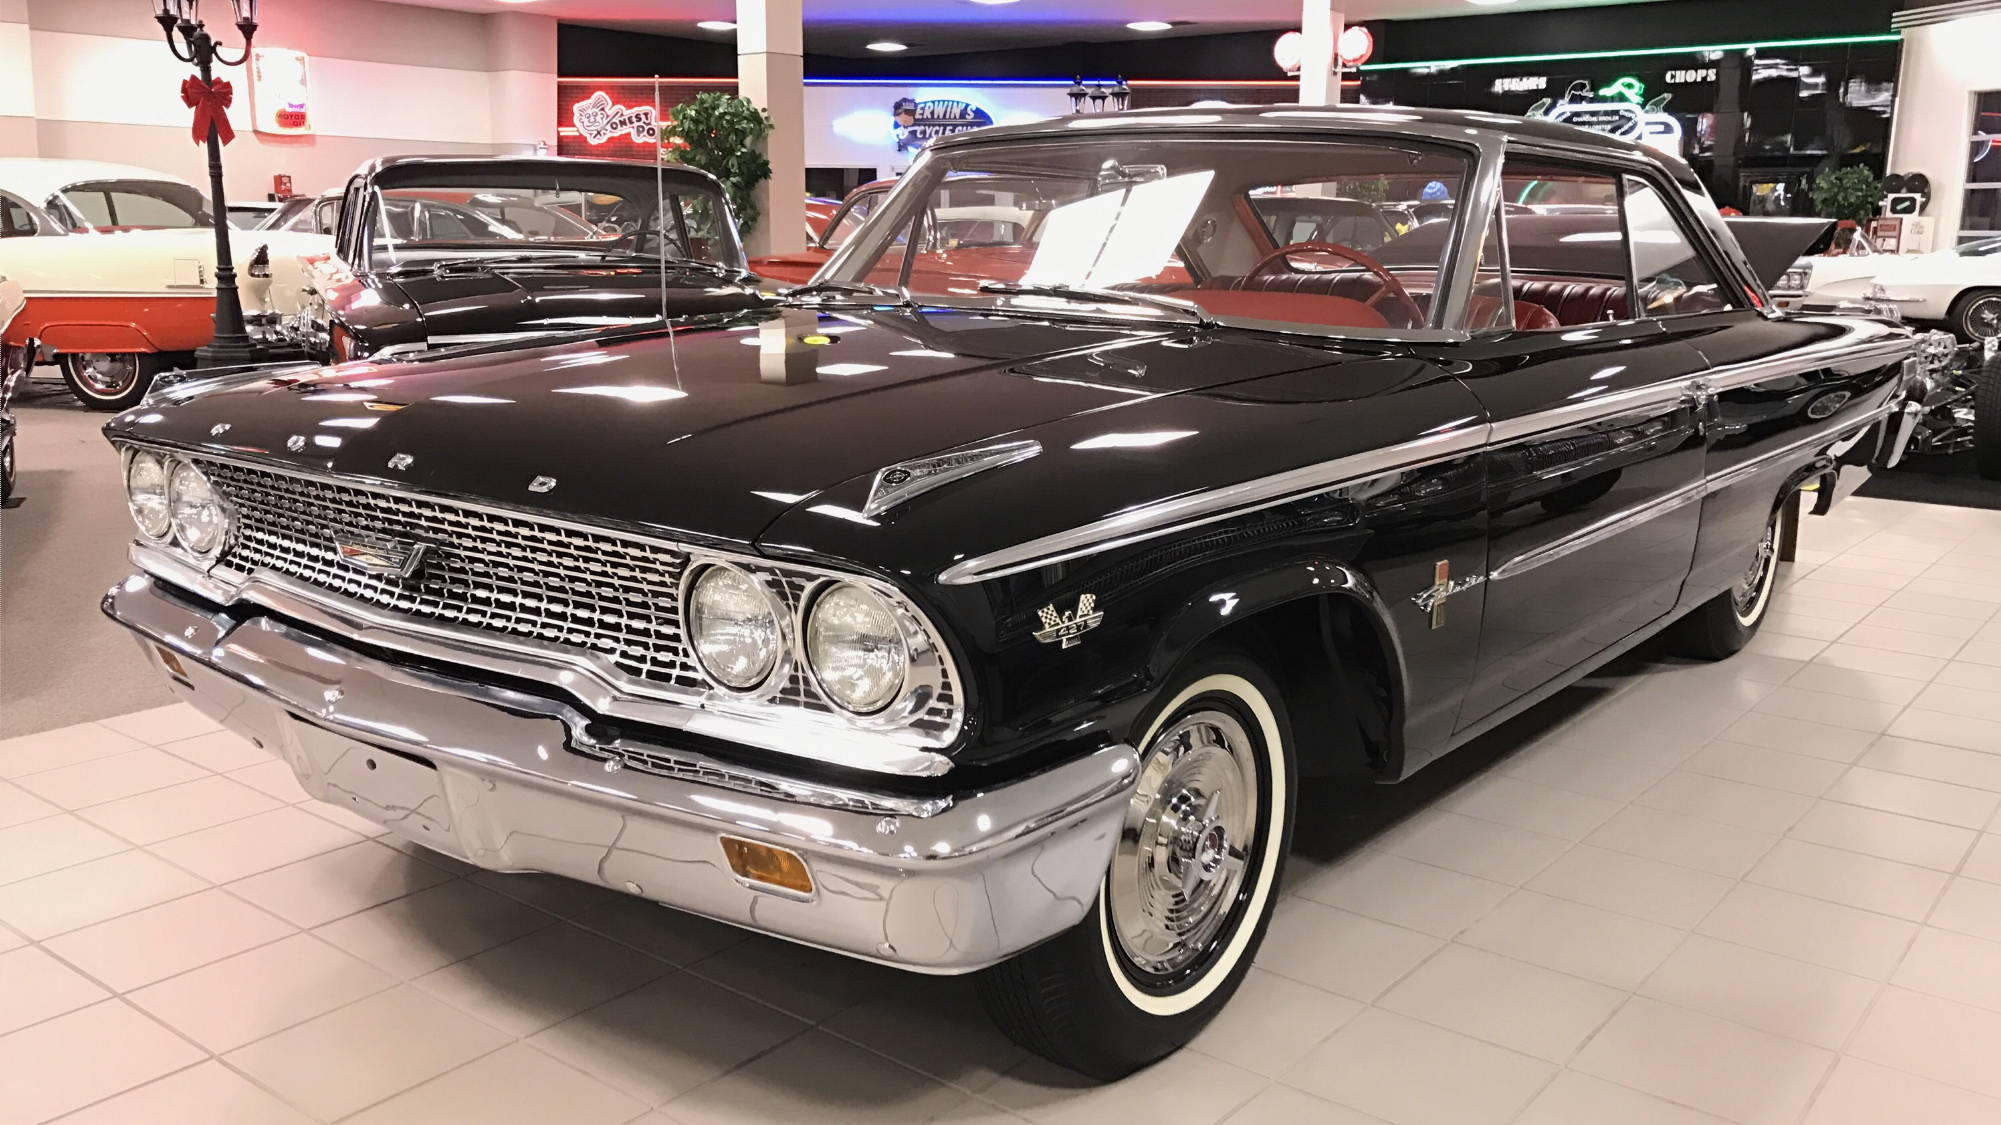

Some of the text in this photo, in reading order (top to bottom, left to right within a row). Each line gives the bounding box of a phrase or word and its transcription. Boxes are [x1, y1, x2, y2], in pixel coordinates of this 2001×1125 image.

[1666, 69, 1717, 84] CHOPS
[915, 101, 977, 120] ERWIN'S
[1058, 621, 1085, 636] 427
